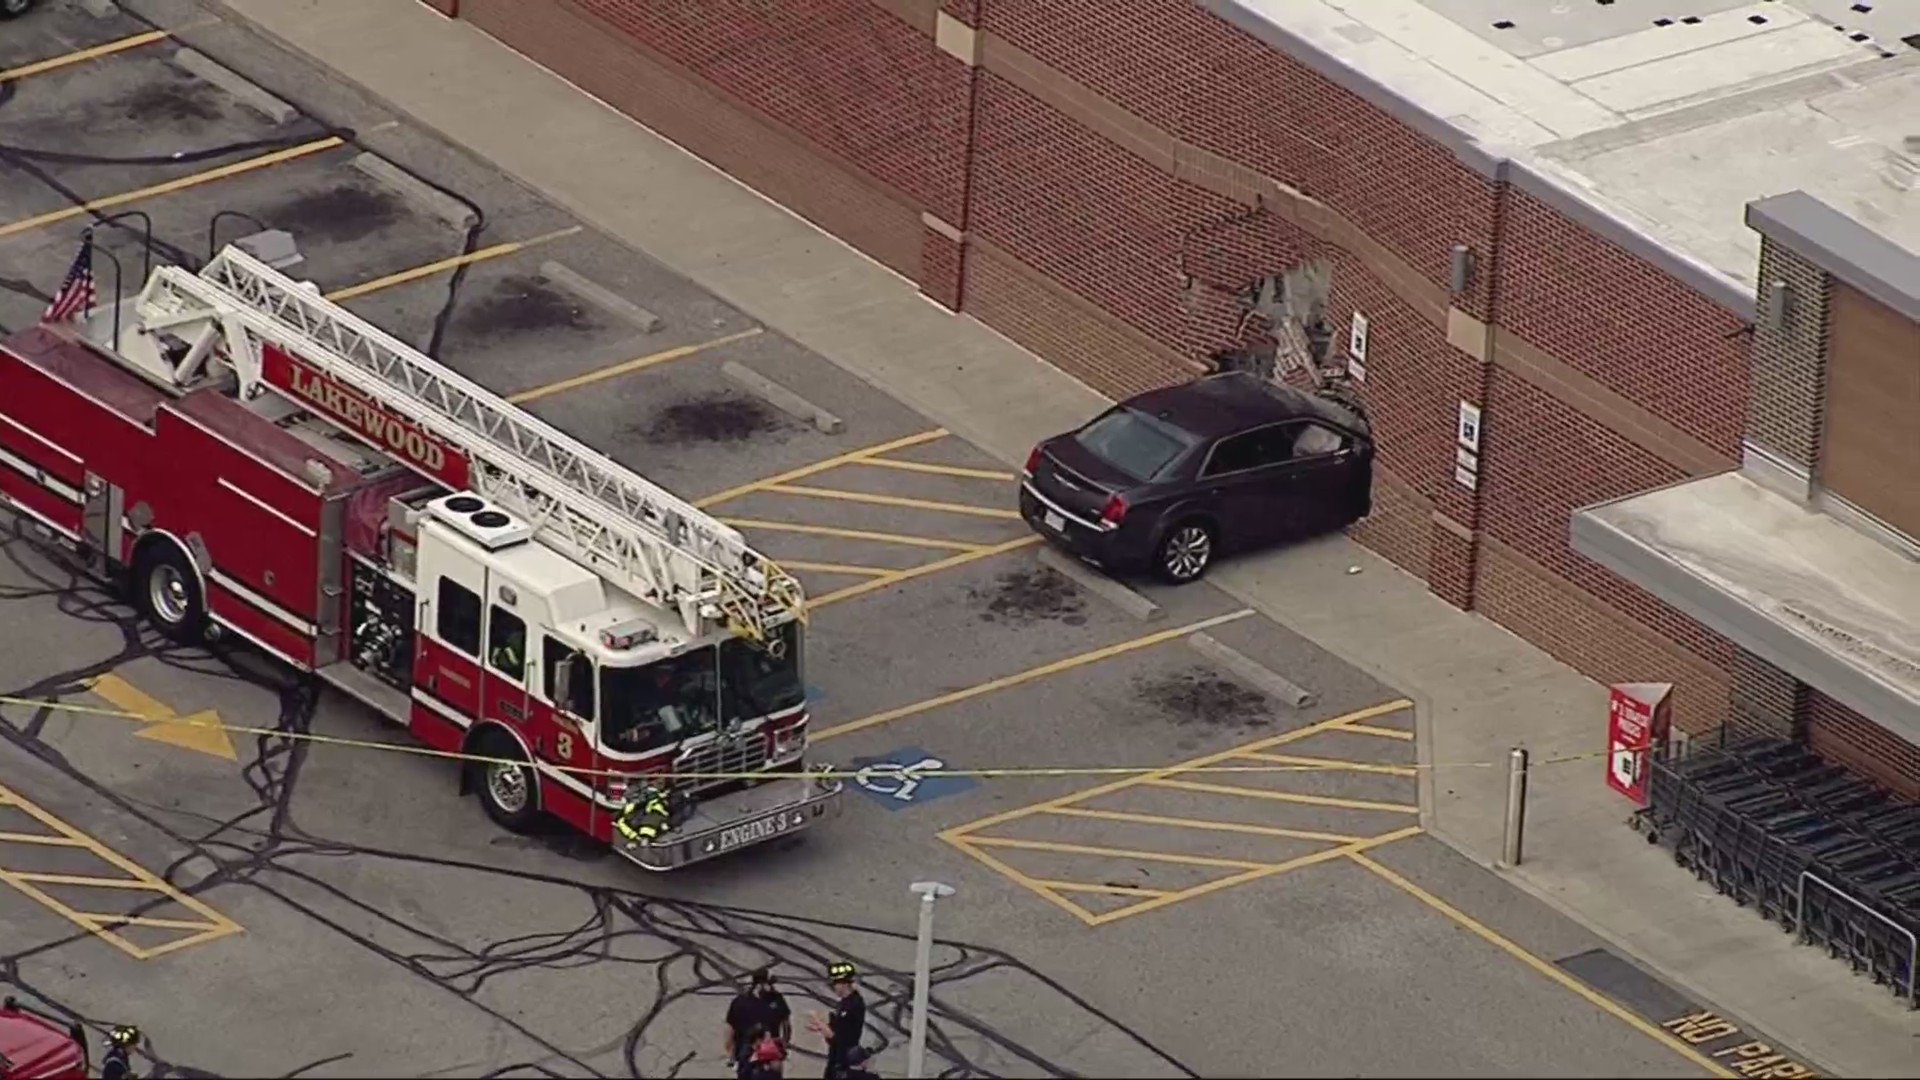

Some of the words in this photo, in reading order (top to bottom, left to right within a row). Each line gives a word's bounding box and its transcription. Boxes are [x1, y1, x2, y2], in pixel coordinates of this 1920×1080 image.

[288, 365, 445, 471] LAKEWOOD
[557, 731, 572, 760] 3
[1662, 1011, 1738, 1044] NO
